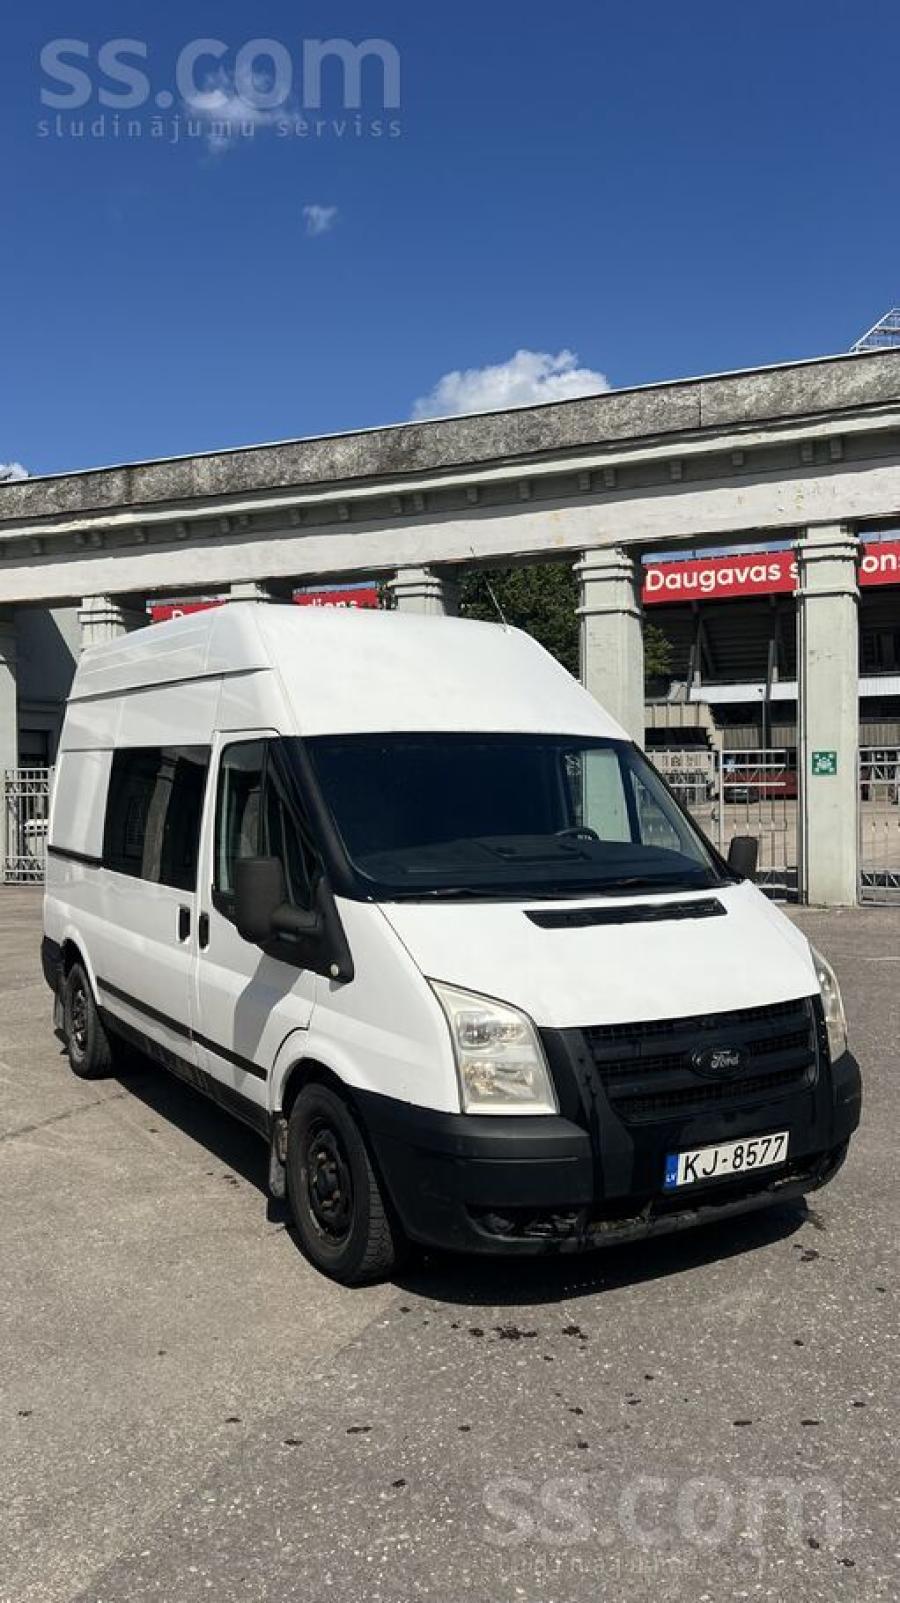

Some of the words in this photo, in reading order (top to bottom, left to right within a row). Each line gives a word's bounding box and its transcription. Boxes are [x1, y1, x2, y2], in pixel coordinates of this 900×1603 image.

[645, 564, 781, 592] Daugavas
[711, 1050, 739, 1069] Ford
[683, 1135, 785, 1182] KJ-8577
